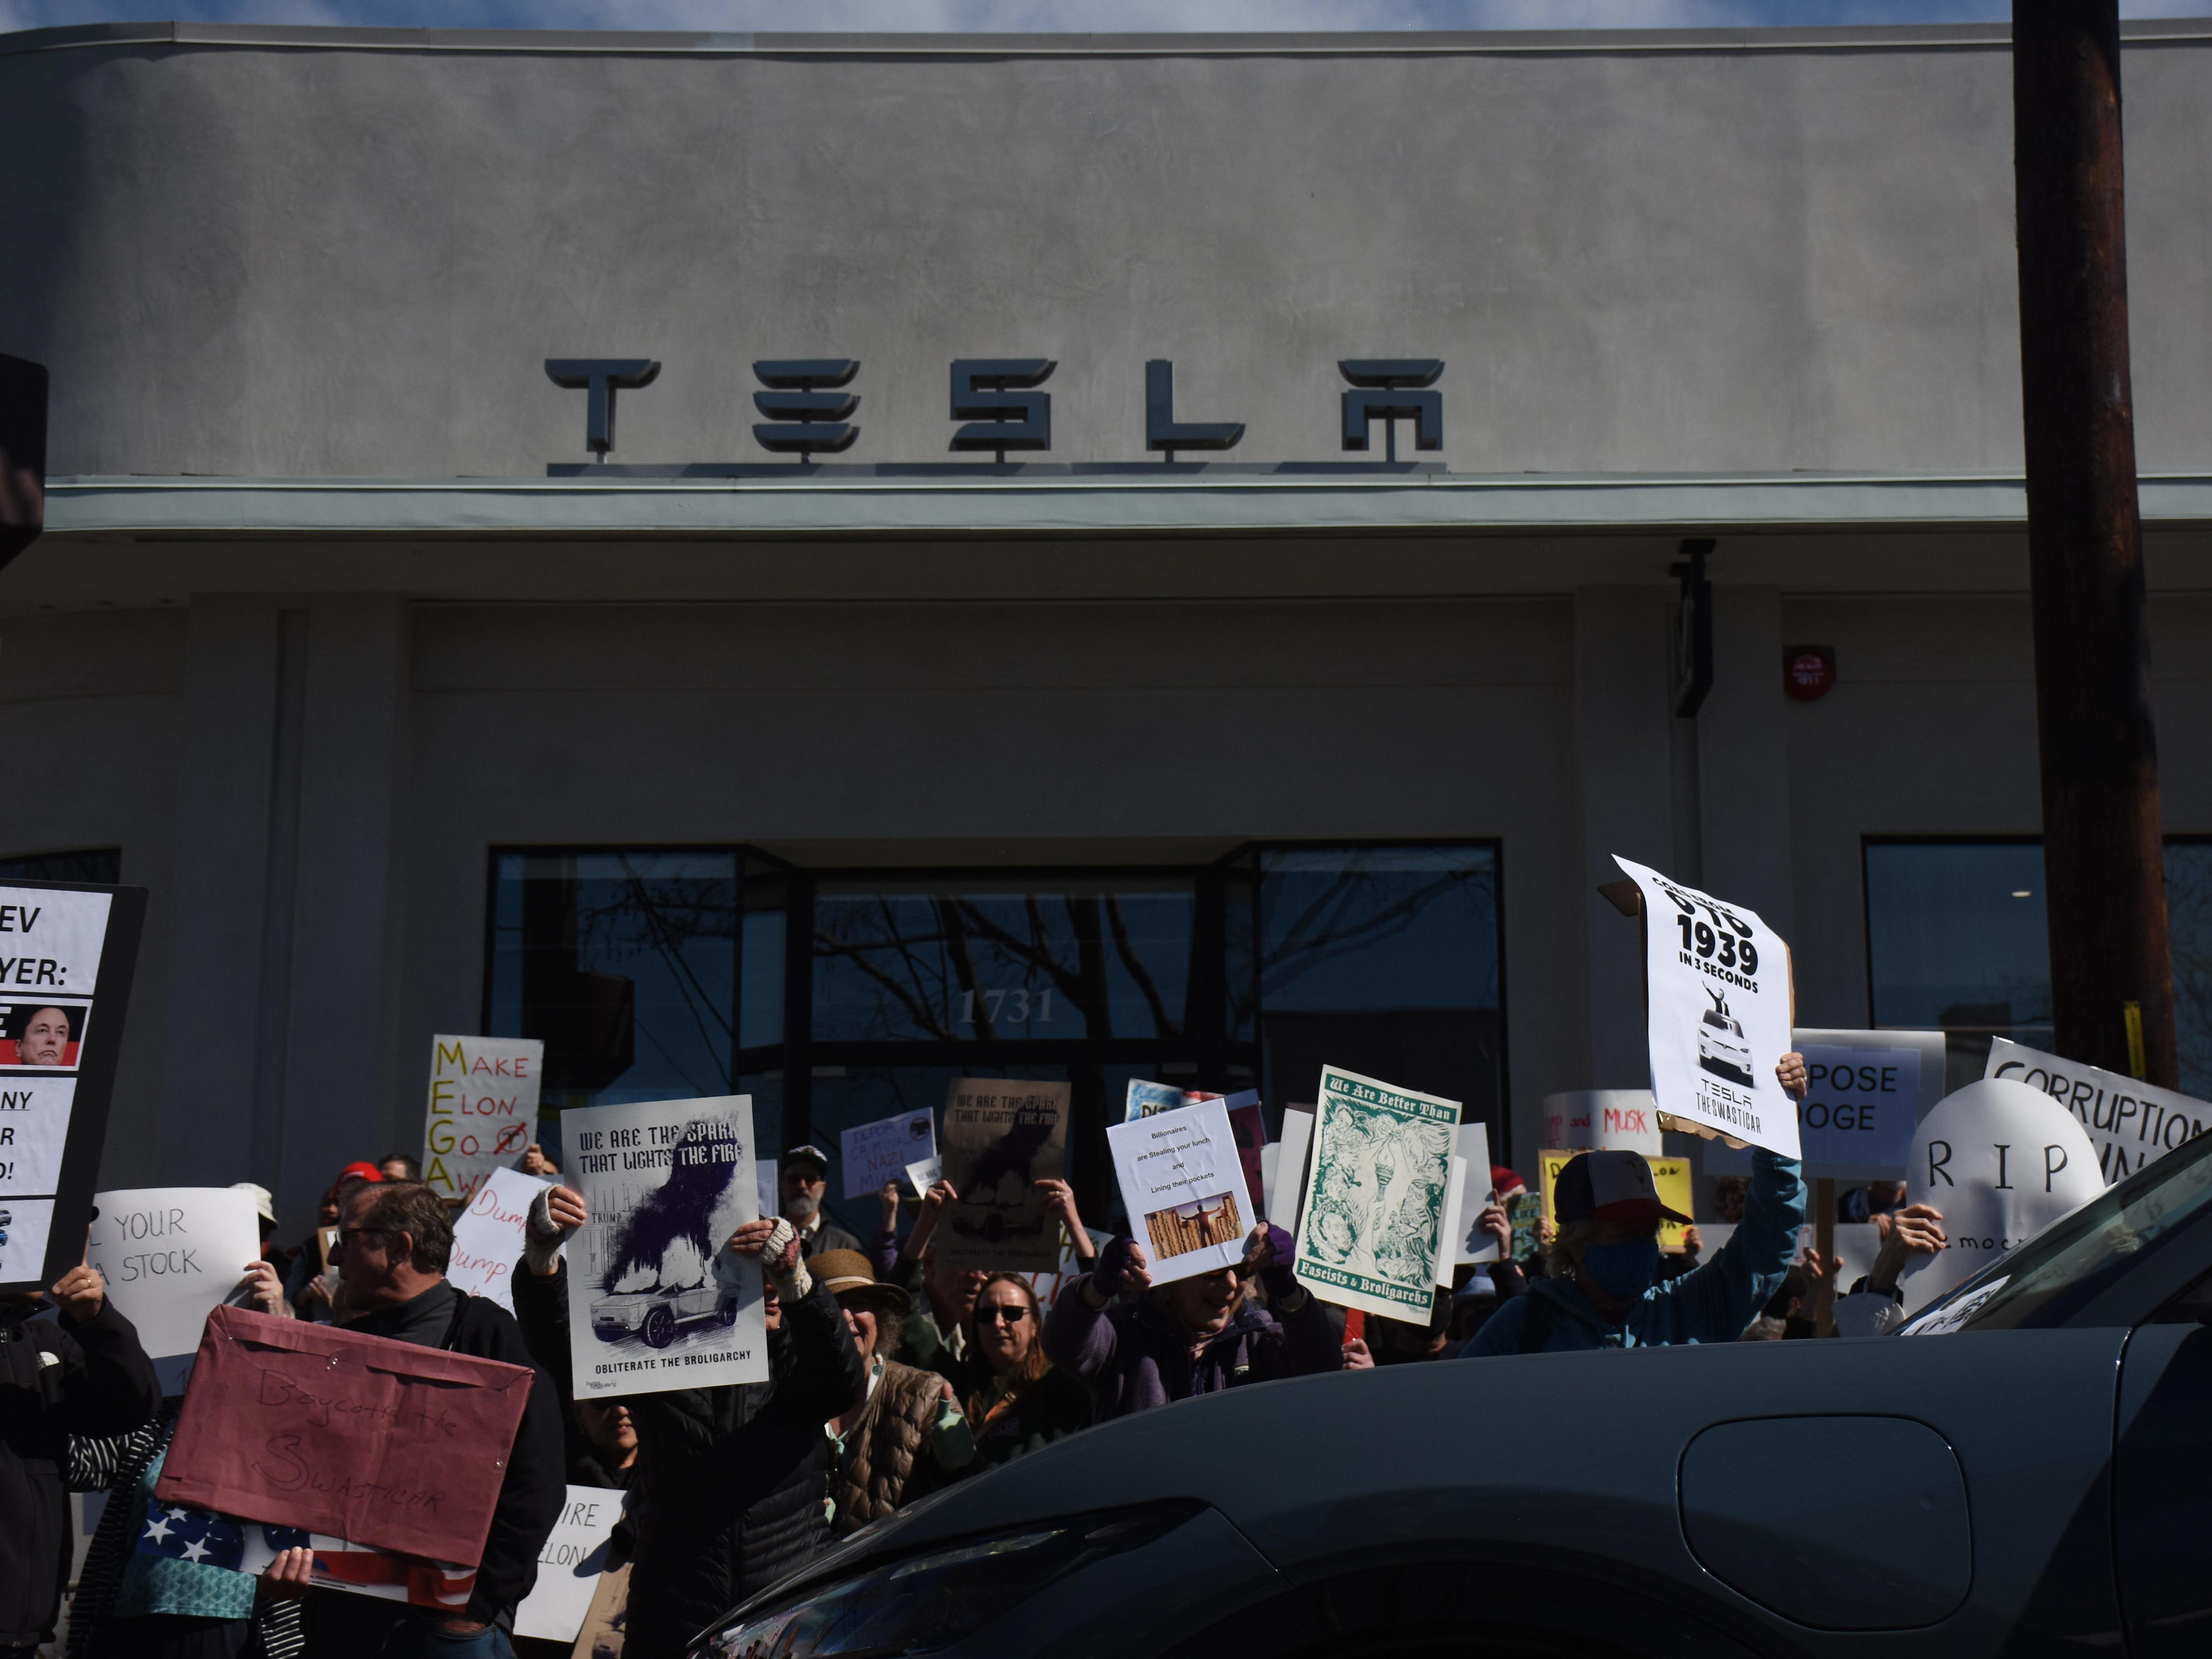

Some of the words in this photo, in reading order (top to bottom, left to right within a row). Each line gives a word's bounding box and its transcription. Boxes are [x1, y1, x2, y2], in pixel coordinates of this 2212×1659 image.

[544, 358, 1445, 451] TESLA
[0, 905, 41, 933] EV
[1677, 913, 1758, 976] 1939
[1679, 951, 1692, 966] IN
[1694, 957, 1701, 970] 3
[1703, 961, 1758, 994] SECONDS
[959, 988, 1054, 1024] 1731
[436, 1040, 529, 1078] MAKE
[1809, 1063, 1898, 1092] POSE
[432, 1080, 517, 1115] ELON
[1329, 1077, 1350, 1092] We
[1352, 1084, 1375, 1101] Are
[1378, 1091, 1417, 1112] Better
[1419, 1102, 1451, 1121] Than
[1701, 1077, 1752, 1110] TESLA
[1570, 1113, 1590, 1128] and
[1604, 1108, 1648, 1134] MUSK
[1797, 1102, 1876, 1130] OGE
[579, 1131, 602, 1150] WE
[611, 1128, 641, 1148] ARE
[648, 1125, 679, 1145] THE
[687, 1120, 737, 1142] SPARK
[1149, 1147, 1175, 1158] Stealing
[1176, 1143, 1191, 1152] your
[1192, 1137, 1210, 1147] lunch
[1151, 1125, 1187, 1139] Billionaires
[579, 1153, 617, 1173] THAT
[623, 1149, 674, 1170] LIGHTS
[678, 1145, 707, 1165] THE
[712, 1142, 742, 1163] FIRE
[426, 1156, 491, 1192] AW
[1151, 1183, 1171, 1193] Lining
[1172, 1179, 1187, 1187] their
[1189, 1172, 1214, 1184] pockets
[114, 1208, 187, 1241] YOUR
[592, 1212, 622, 1223] TRUMP
[121, 1249, 202, 1281] STOCK
[1300, 1260, 1348, 1285] Fascists
[1350, 1277, 1357, 1286] &
[1359, 1278, 1428, 1305] Broligarchs
[596, 1358, 656, 1374] OBLITERATE
[661, 1357, 680, 1368] THE
[685, 1350, 751, 1366] BROLIGARCHY
[414, 1409, 457, 1436] the
[561, 1502, 600, 1527] IRE
